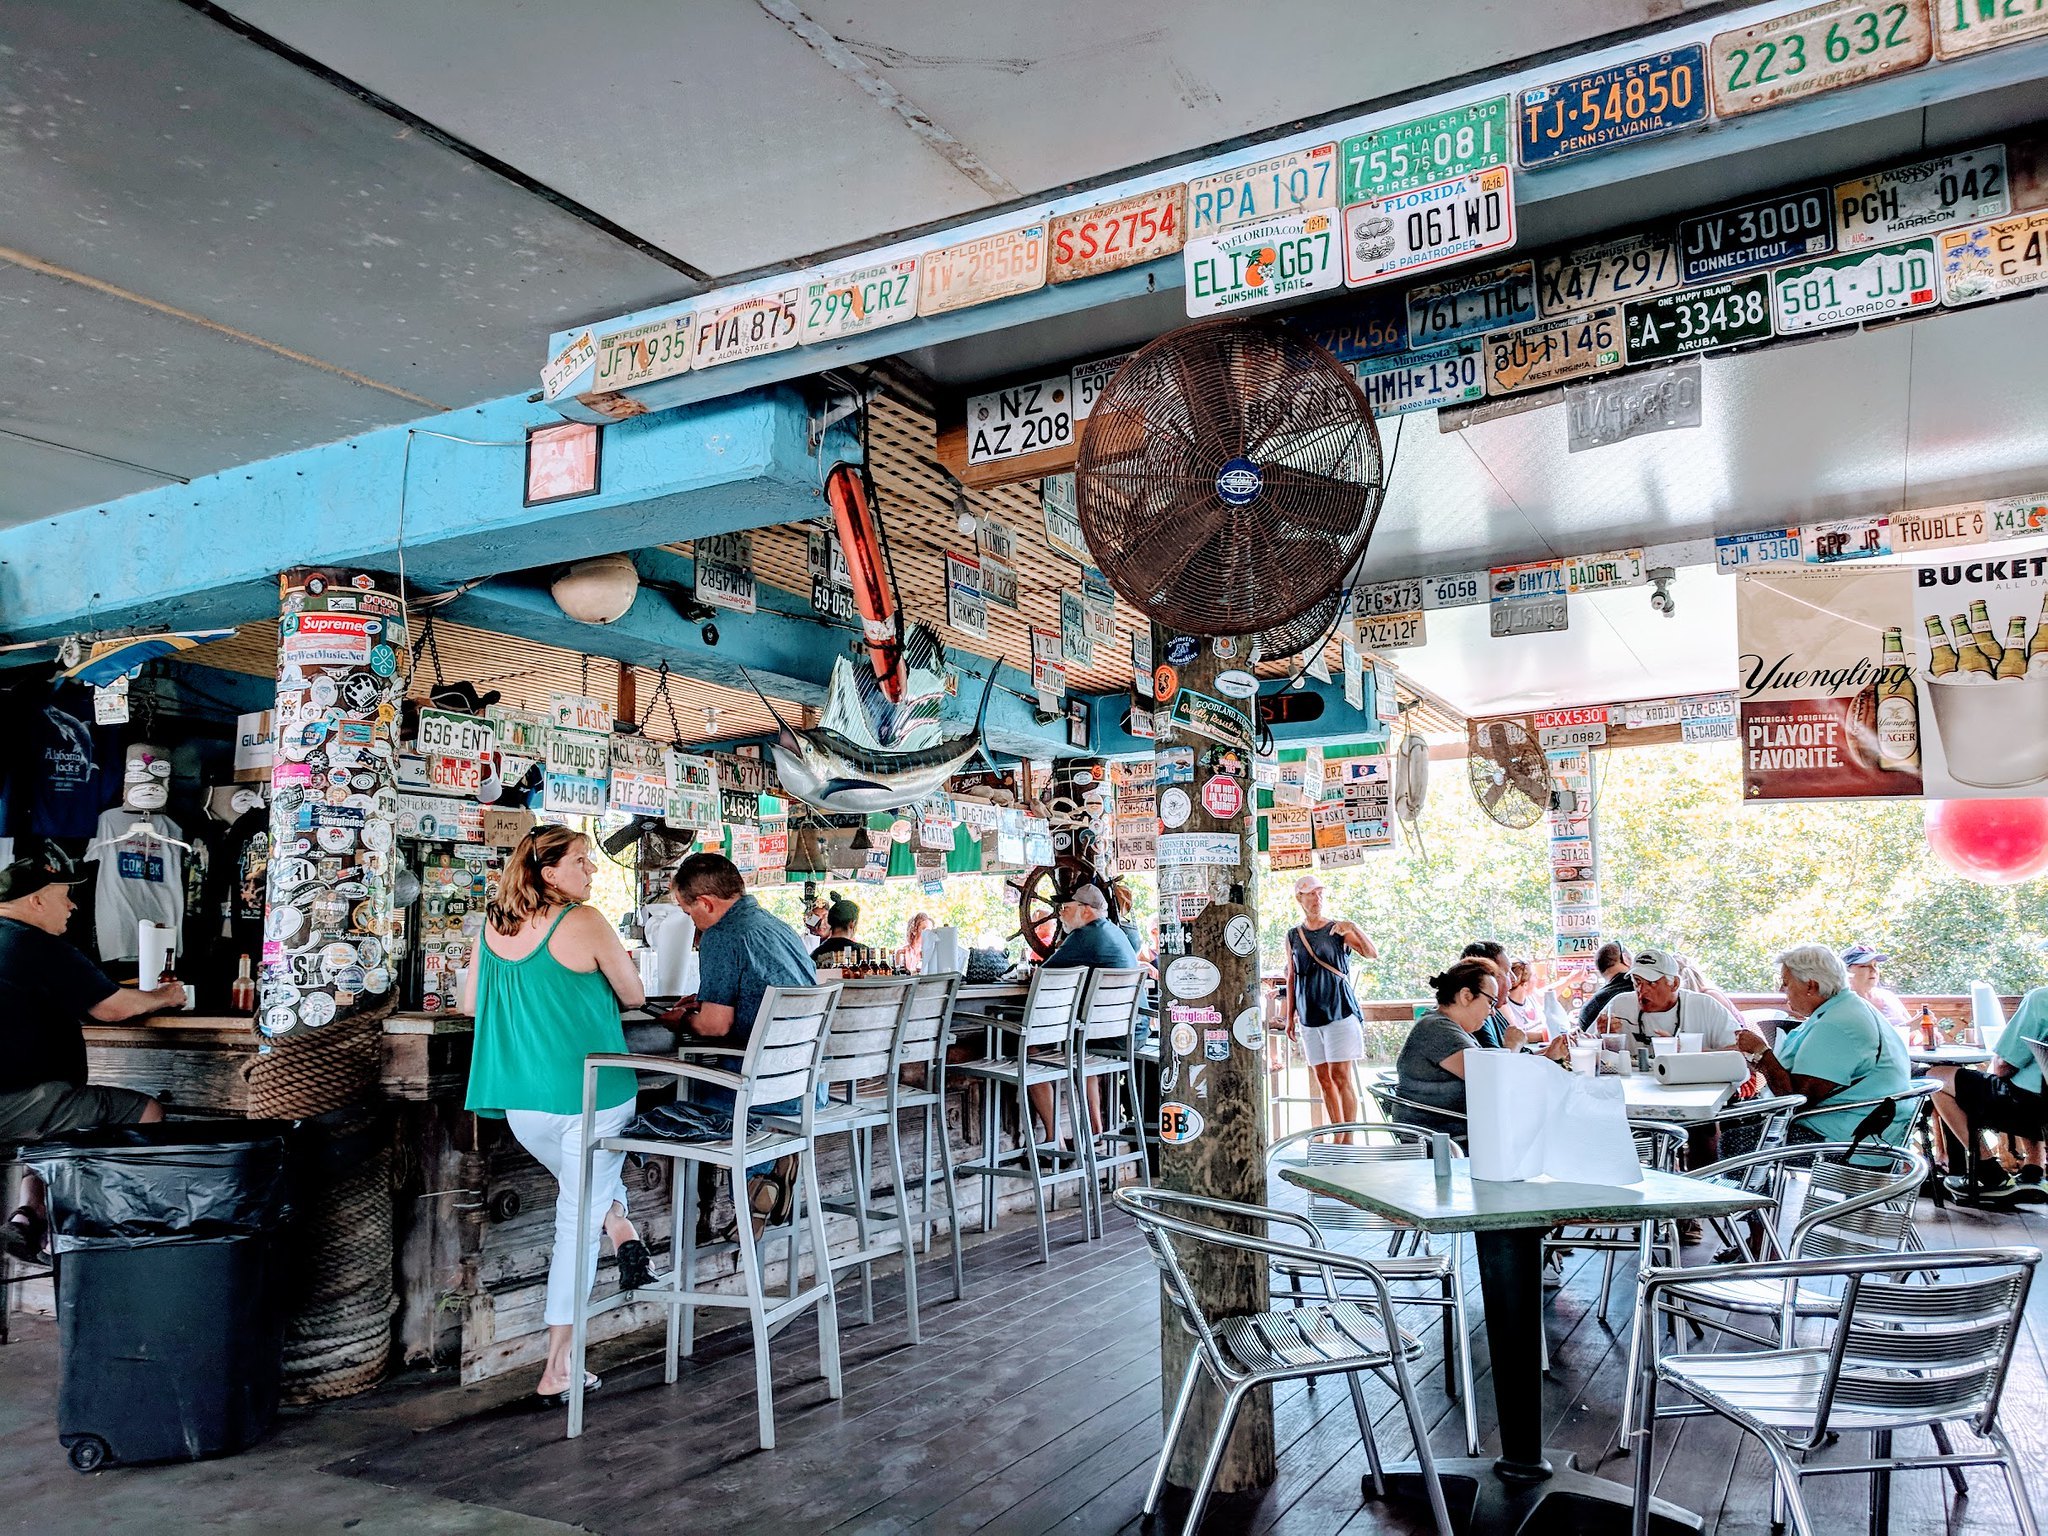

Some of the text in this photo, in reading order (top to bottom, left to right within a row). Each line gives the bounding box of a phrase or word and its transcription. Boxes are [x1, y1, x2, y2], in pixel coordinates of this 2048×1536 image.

[1728, 3, 1910, 92] 223 632
[1568, 62, 1650, 93] TRAILER
[1352, 136, 1387, 151] BOAT
[1397, 117, 1457, 142] TRAILER
[1560, 115, 1663, 152] PENNSYLVANIA
[1349, 121, 1493, 188] 755 LA 081
[1412, 157, 1430, 172] 75
[1225, 157, 1297, 183] GEORGIA
[1195, 161, 1330, 229] RPA 107
[1357, 177, 1418, 199] EXPIRES
[1384, 181, 1467, 214] FLORIDA
[1842, 163, 2001, 230] PGH 042
[1409, 192, 1500, 250] 061WD
[1887, 210, 1955, 233] HARRISON
[950, 236, 1016, 259] FLORIDA
[1217, 223, 1305, 253] MYFLORIDA.COM
[1194, 233, 1331, 300] ELI G67
[1382, 240, 1477, 271] US PARATROOPER
[1690, 241, 1787, 275] CONNECTICUT
[834, 267, 887, 286] FLORIDA
[808, 275, 910, 328] 299 CRZ
[1220, 278, 1306, 306] SUNSHINE STATE
[1658, 284, 1732, 307] ONE HAPPY ISLAND
[733, 298, 764, 314] HAWAII
[1817, 299, 1896, 322] COLORADO
[698, 303, 796, 355] FVA 875
[1640, 290, 1764, 347] A-33438
[622, 323, 667, 338] FLORIDA
[601, 331, 685, 379] JFY 935
[718, 343, 769, 360] ALOHA STATE
[1677, 336, 1719, 351] ARUBA
[1392, 348, 1450, 368] Minnesota
[1528, 361, 1590, 381] WEST VIRGINIA
[971, 412, 1069, 460] AZ 208
[1890, 514, 1920, 525] Illinois
[1900, 516, 1967, 543] TRUBLE
[1993, 508, 2026, 532] X43
[1736, 532, 1780, 543] MICHIGAN
[1860, 528, 1881, 550] JR
[1436, 573, 1477, 584] CONNECTICUT
[1519, 569, 1562, 591] GHY7X
[1570, 563, 1622, 586] BADGRL
[1995, 582, 2019, 590] ALL
[1437, 581, 1477, 600] 6058
[303, 616, 364, 633] Supreme
[1739, 652, 1918, 700] Yuengling
[1748, 713, 1839, 724] AMERICA'S ORIGINAL
[1748, 722, 1838, 748] PLAYOFF
[1879, 732, 1916, 742] LAGER
[437, 746, 474, 758] COLORADO
[1749, 748, 1844, 771] FAVORITE.
[1282, 770, 1297, 782] BIG
[1356, 784, 1387, 797] TOWING
[722, 796, 759, 820] C4682
[319, 815, 365, 828] Everglades
[1348, 826, 1388, 840] YELO 67
[1553, 824, 1575, 837] KEYS
[1186, 840, 1209, 848] STORE
[1119, 859, 1137, 870] BOY
[1171, 1010, 1222, 1025] Everglades
